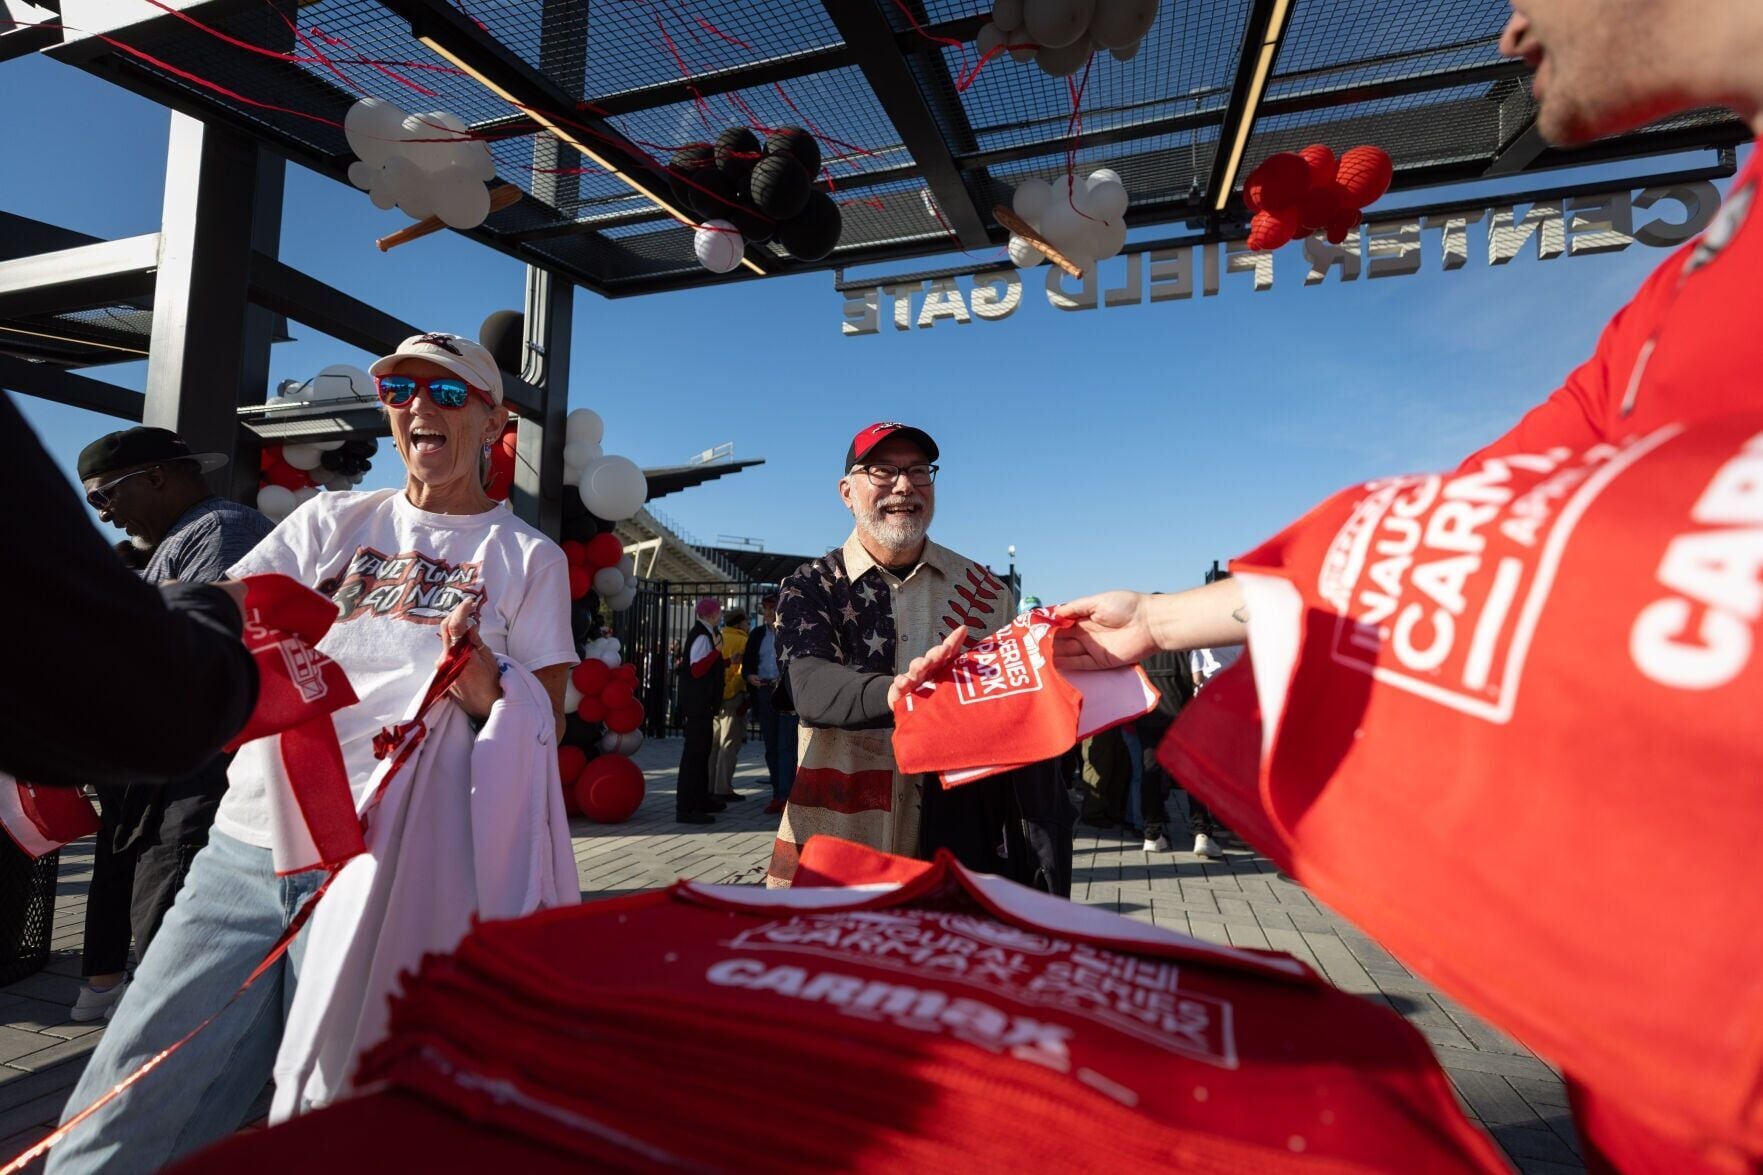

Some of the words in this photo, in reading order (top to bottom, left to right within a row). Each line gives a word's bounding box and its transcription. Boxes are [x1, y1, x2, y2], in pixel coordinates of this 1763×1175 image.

[1392, 446, 1571, 671] CARM
[1629, 431, 1763, 690] CAR
[358, 583, 407, 612] GO
[973, 642, 1008, 694] PARK
[999, 638, 1030, 687] SERIES
